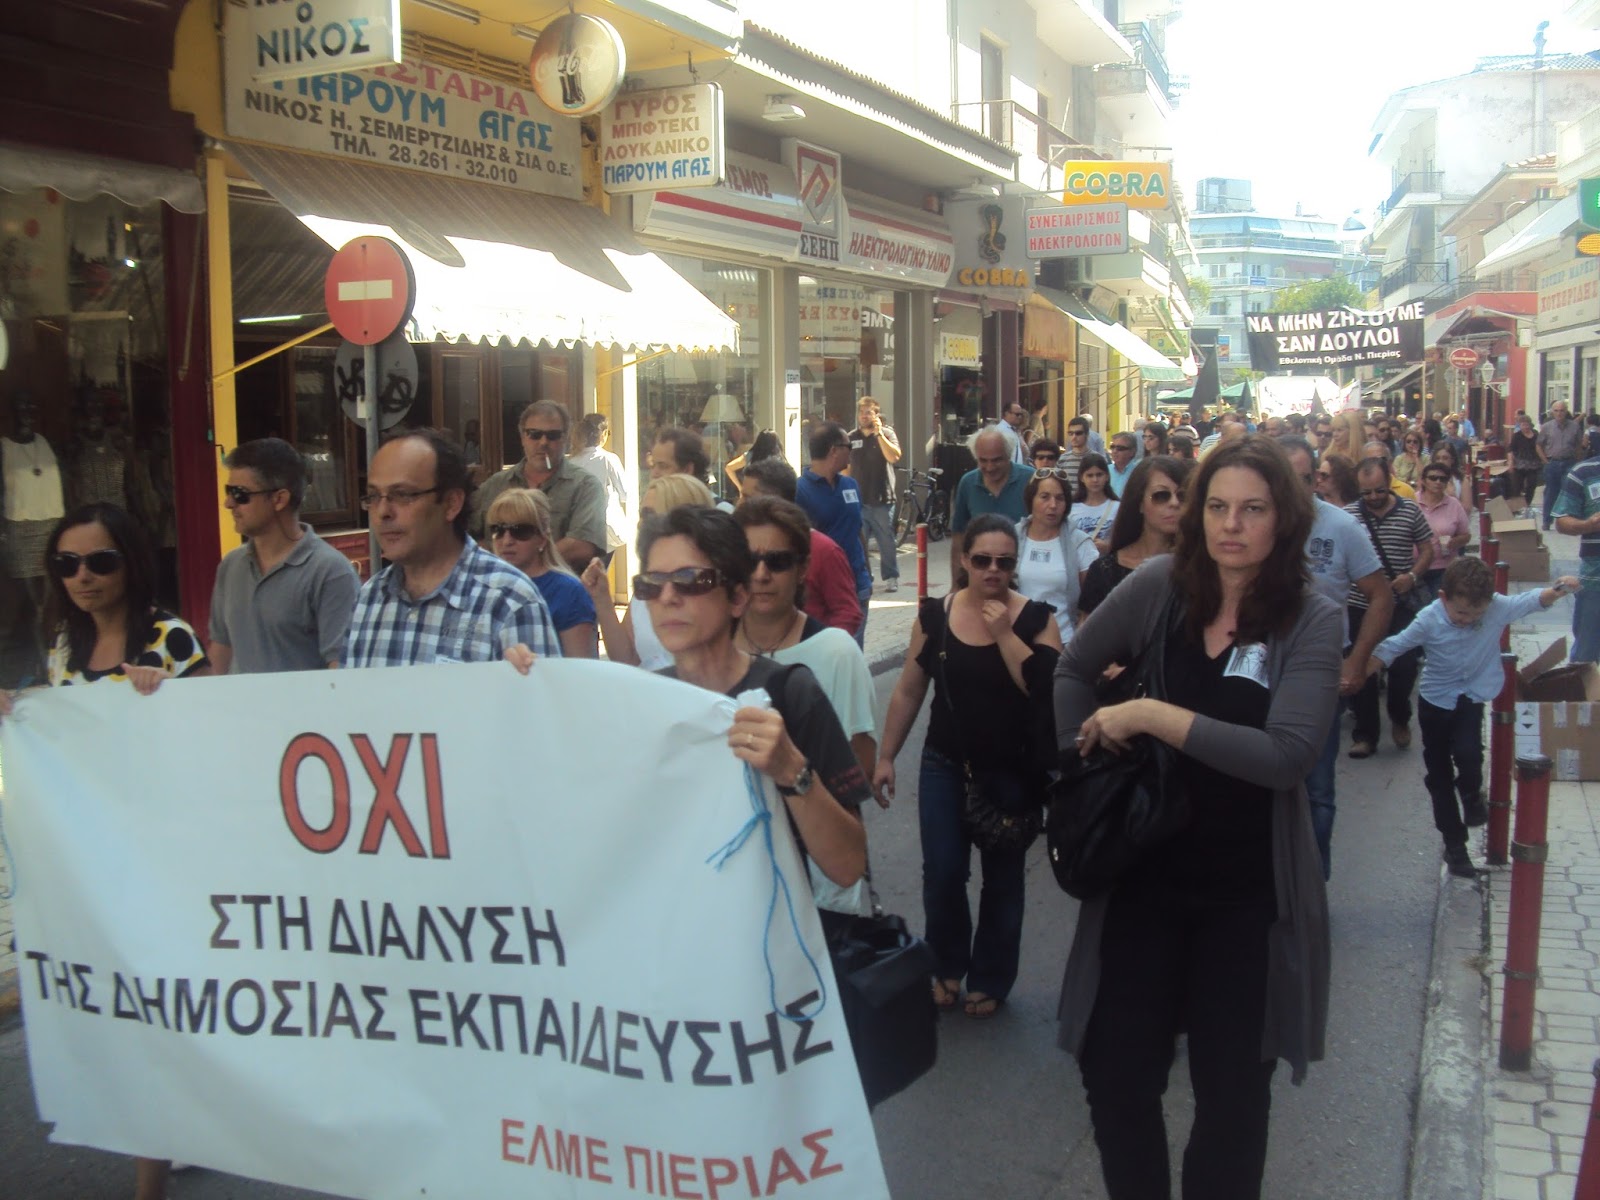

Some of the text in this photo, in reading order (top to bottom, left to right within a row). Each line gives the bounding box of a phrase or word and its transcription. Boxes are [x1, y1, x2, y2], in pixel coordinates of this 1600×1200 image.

[257, 17, 370, 67] ΝΙΚΟΣ
[361, 59, 529, 116] ΣΤΑΡΙΑ
[274, 72, 553, 152] ΙΑΡΟΥΜ ΑΓΑΣ
[614, 93, 696, 120] ΓΥΡΟΣ
[245, 88, 323, 125] ΝΙΚΟΣ
[330, 108, 353, 131] Η.
[359, 115, 497, 161] ΣΕΜΕΡΤΖΙΔΗΣ
[499, 146, 511, 164] &
[515, 150, 543, 171] ΣΙΑ
[612, 116, 700, 139] ΜΠΙΦΤΕΚΙ
[330, 131, 377, 157] ΤΗΛ.
[389, 143, 448, 171] 28.261
[466, 159, 518, 184] 32.010
[604, 136, 710, 161] ΛΟΥΚΑΝΙΚΟ
[604, 157, 711, 185] ΓΙΑΡΟΥΜ ΑΓΑΣ
[1067, 171, 1166, 197] COBRA
[1029, 210, 1121, 229] ΣΥΝΕΤΑΙΡΙΣΜΟΣ
[800, 234, 839, 262] ΣΕΗΠ
[849, 231, 951, 274] ΗΛΕΚΤΡΟΛΟΓΙΚΟ ΥΛΙΚΟ
[1029, 232, 1122, 251] ΗΛΕΚΤΡΟΛΟΓΩΝ
[958, 266, 1030, 288] COBRA
[1247, 301, 1425, 333] ΝΑ ΜΗΝ ΖΗΣΟΥΜΕ
[1276, 326, 1400, 353] ΣΑΝ ΔΟΥΛΟΙ
[279, 731, 451, 859] ΟΧΙ
[210, 894, 567, 967] ΣΤΗ ΔΙΑΛΥΣΗ
[25, 951, 834, 1087] ΤΗΣ ΔΗΜΟΣΙΑΣ ΕΚΠΑΙΔΕΥΣΗΣ
[501, 1117, 844, 1200] ΕΛΜΕ ΠΙΕΡΙΑΣ
